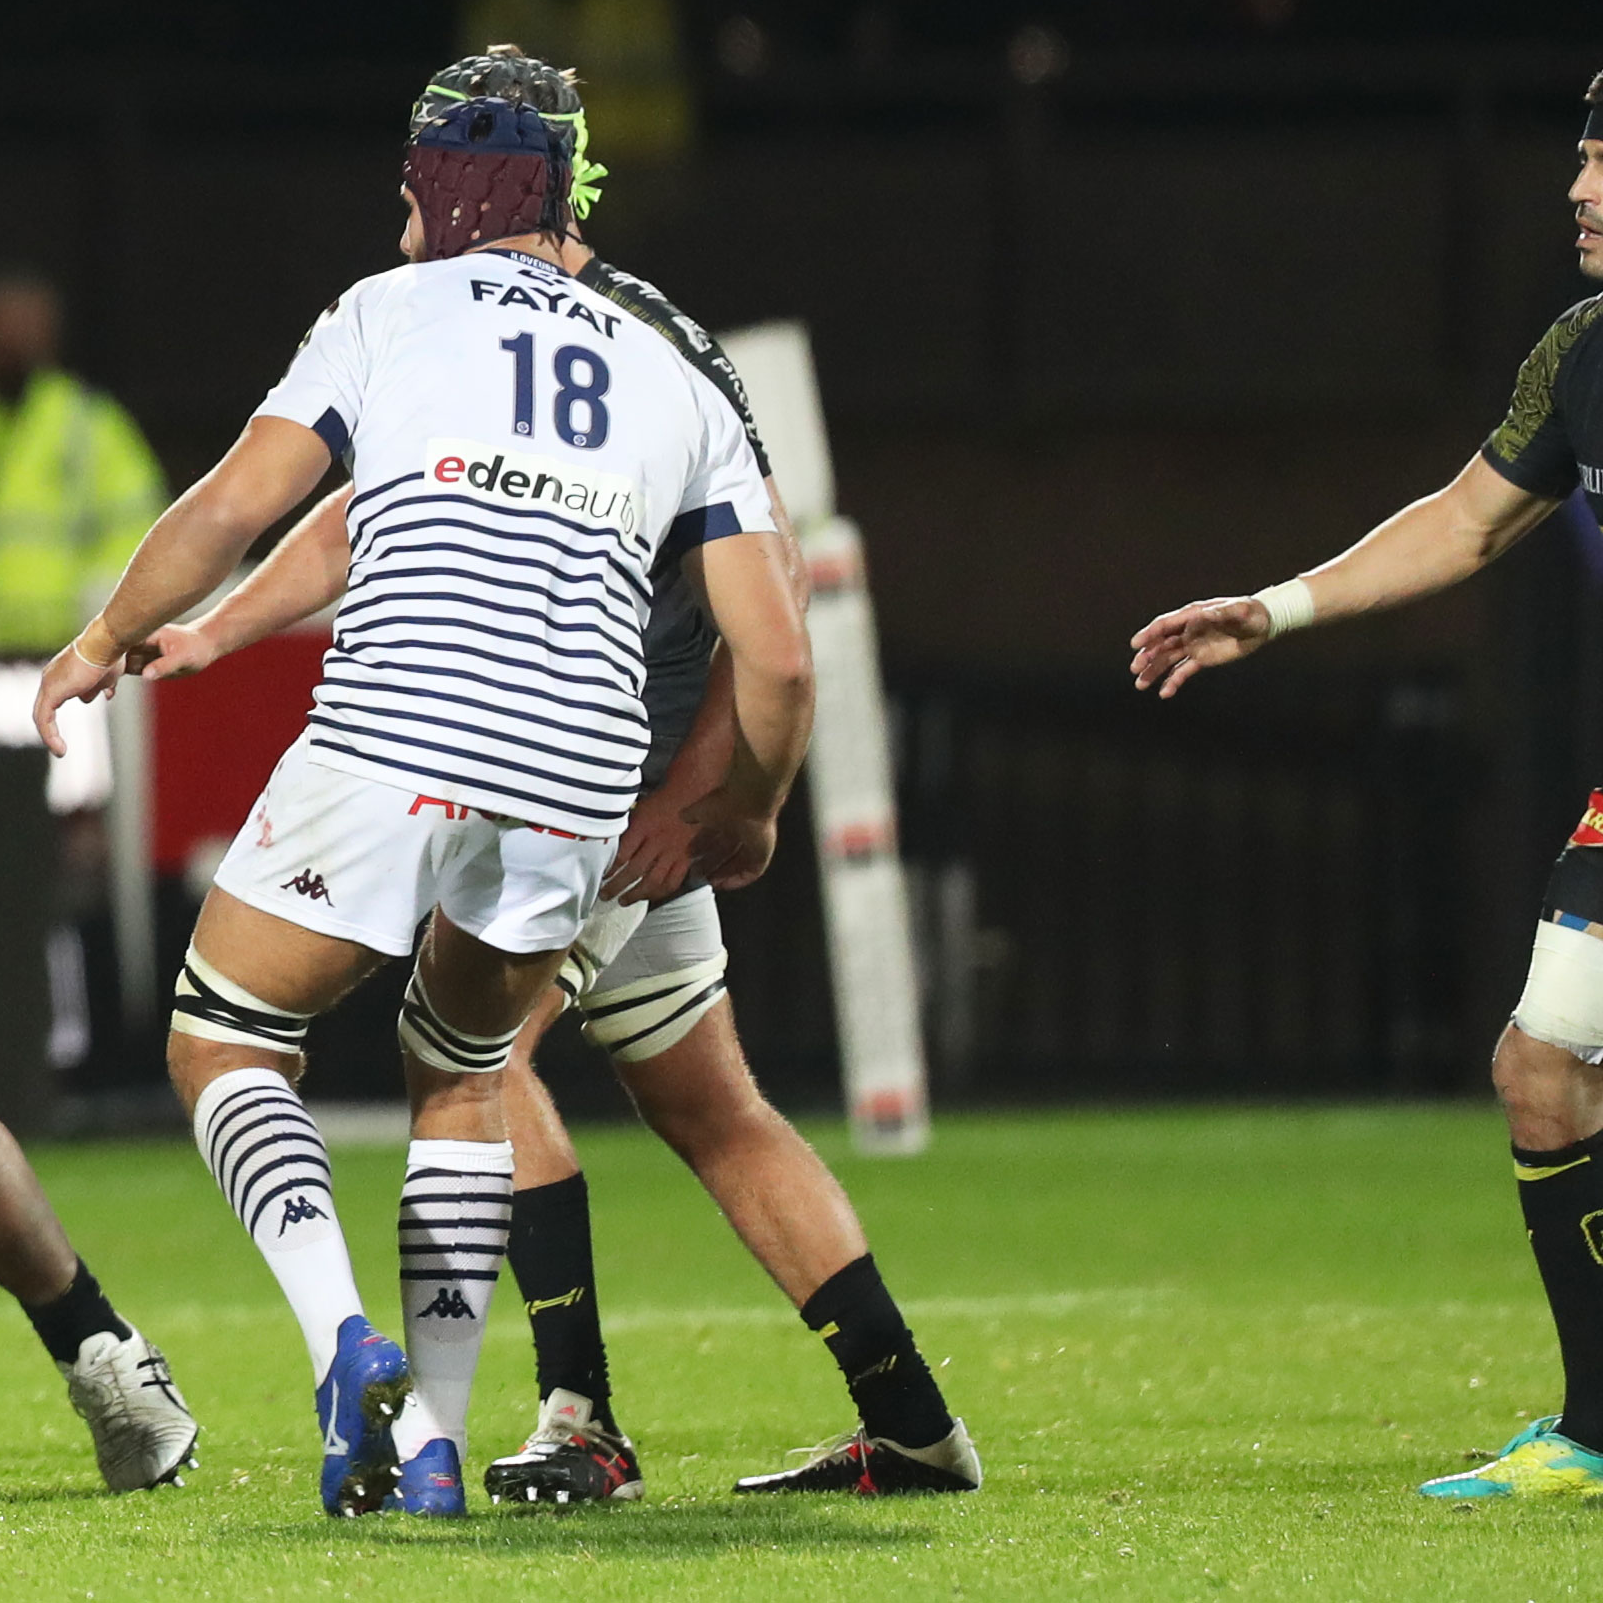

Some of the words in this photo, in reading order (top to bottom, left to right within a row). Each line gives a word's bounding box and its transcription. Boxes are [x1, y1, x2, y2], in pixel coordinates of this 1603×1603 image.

[470, 279, 622, 339] FAYAT
[499, 329, 612, 451] 18
[434, 454, 634, 535] edenauto
